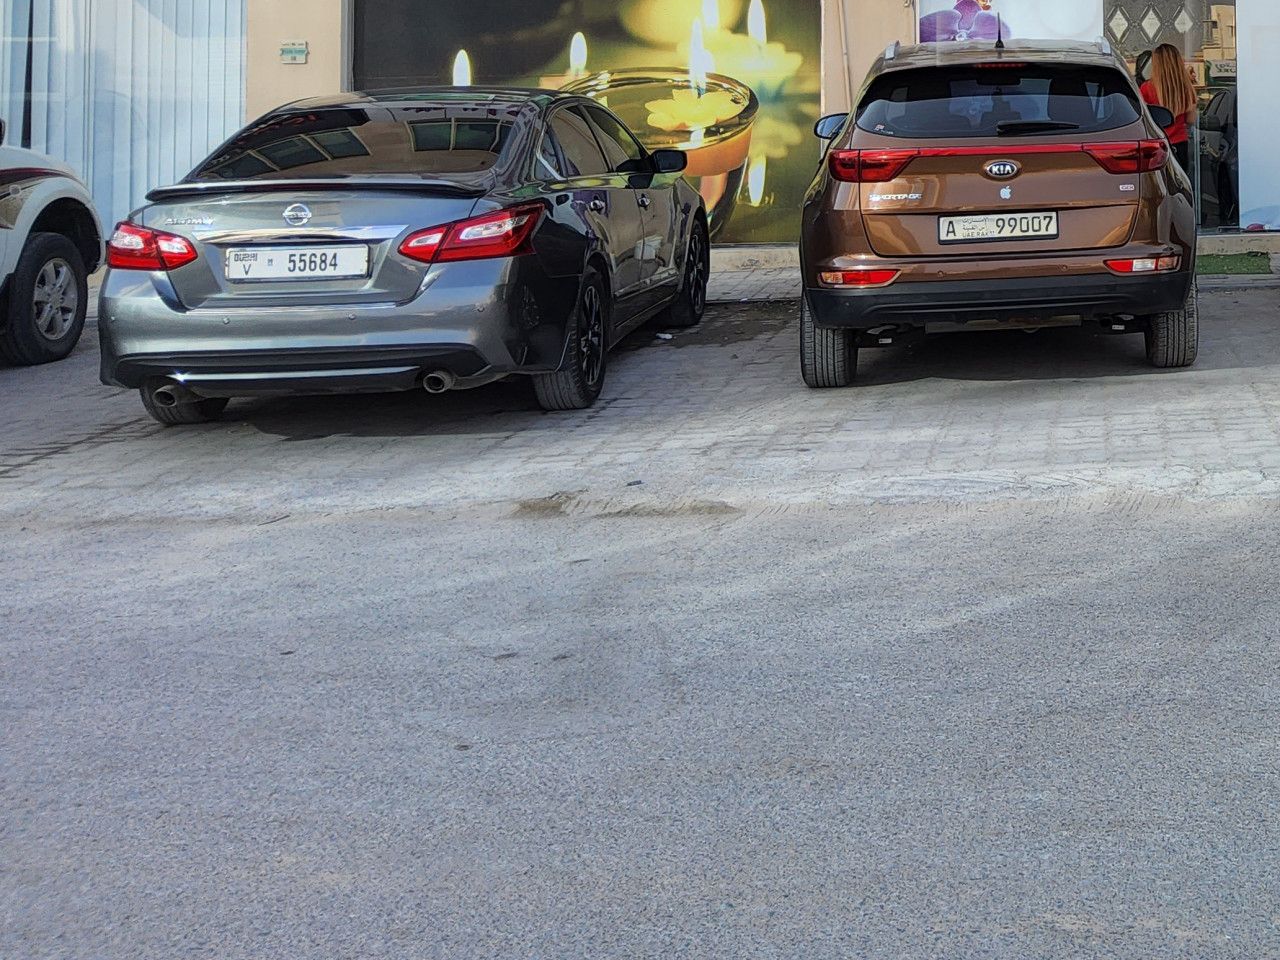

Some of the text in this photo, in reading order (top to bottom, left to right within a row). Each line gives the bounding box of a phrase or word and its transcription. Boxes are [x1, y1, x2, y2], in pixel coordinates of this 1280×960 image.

[991, 165, 1013, 175] KIA
[945, 220, 956, 237] A
[995, 215, 1053, 235] 99007
[243, 263, 252, 276] V
[287, 252, 338, 273] 55684
